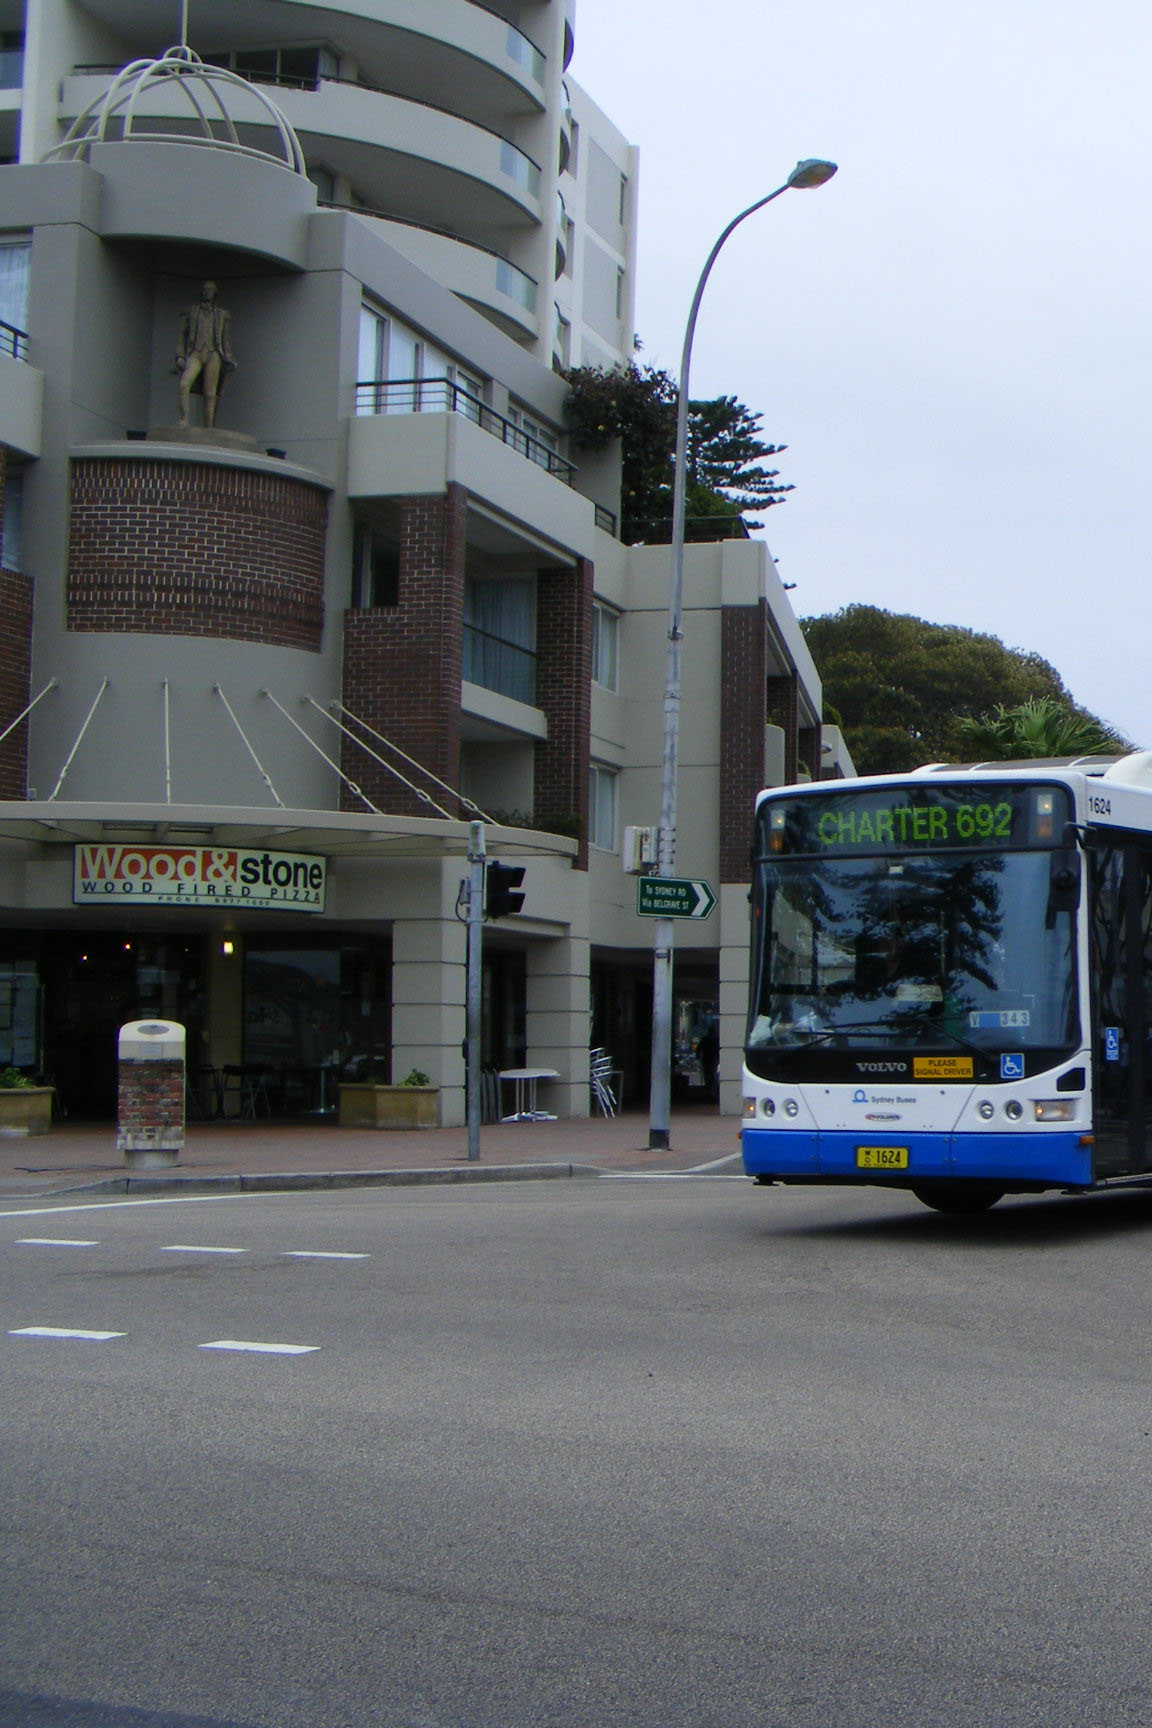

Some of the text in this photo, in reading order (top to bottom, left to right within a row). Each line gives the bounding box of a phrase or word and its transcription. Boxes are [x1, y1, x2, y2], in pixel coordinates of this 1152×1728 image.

[1088, 796, 1111, 815] 1624
[818, 803, 1013, 844] CHARTER 692
[82, 882, 320, 902] WOOD FIRED PIZZA
[157, 895, 200, 903] PHONE
[1001, 1012, 1028, 1026] 343
[856, 1063, 907, 1072] VOLVO
[928, 1059, 957, 1067] PLEASE
[915, 1068, 972, 1076] SIGNAL DRIVER
[871, 1096, 895, 1104] Sydney
[877, 1150, 901, 1163] 1624
